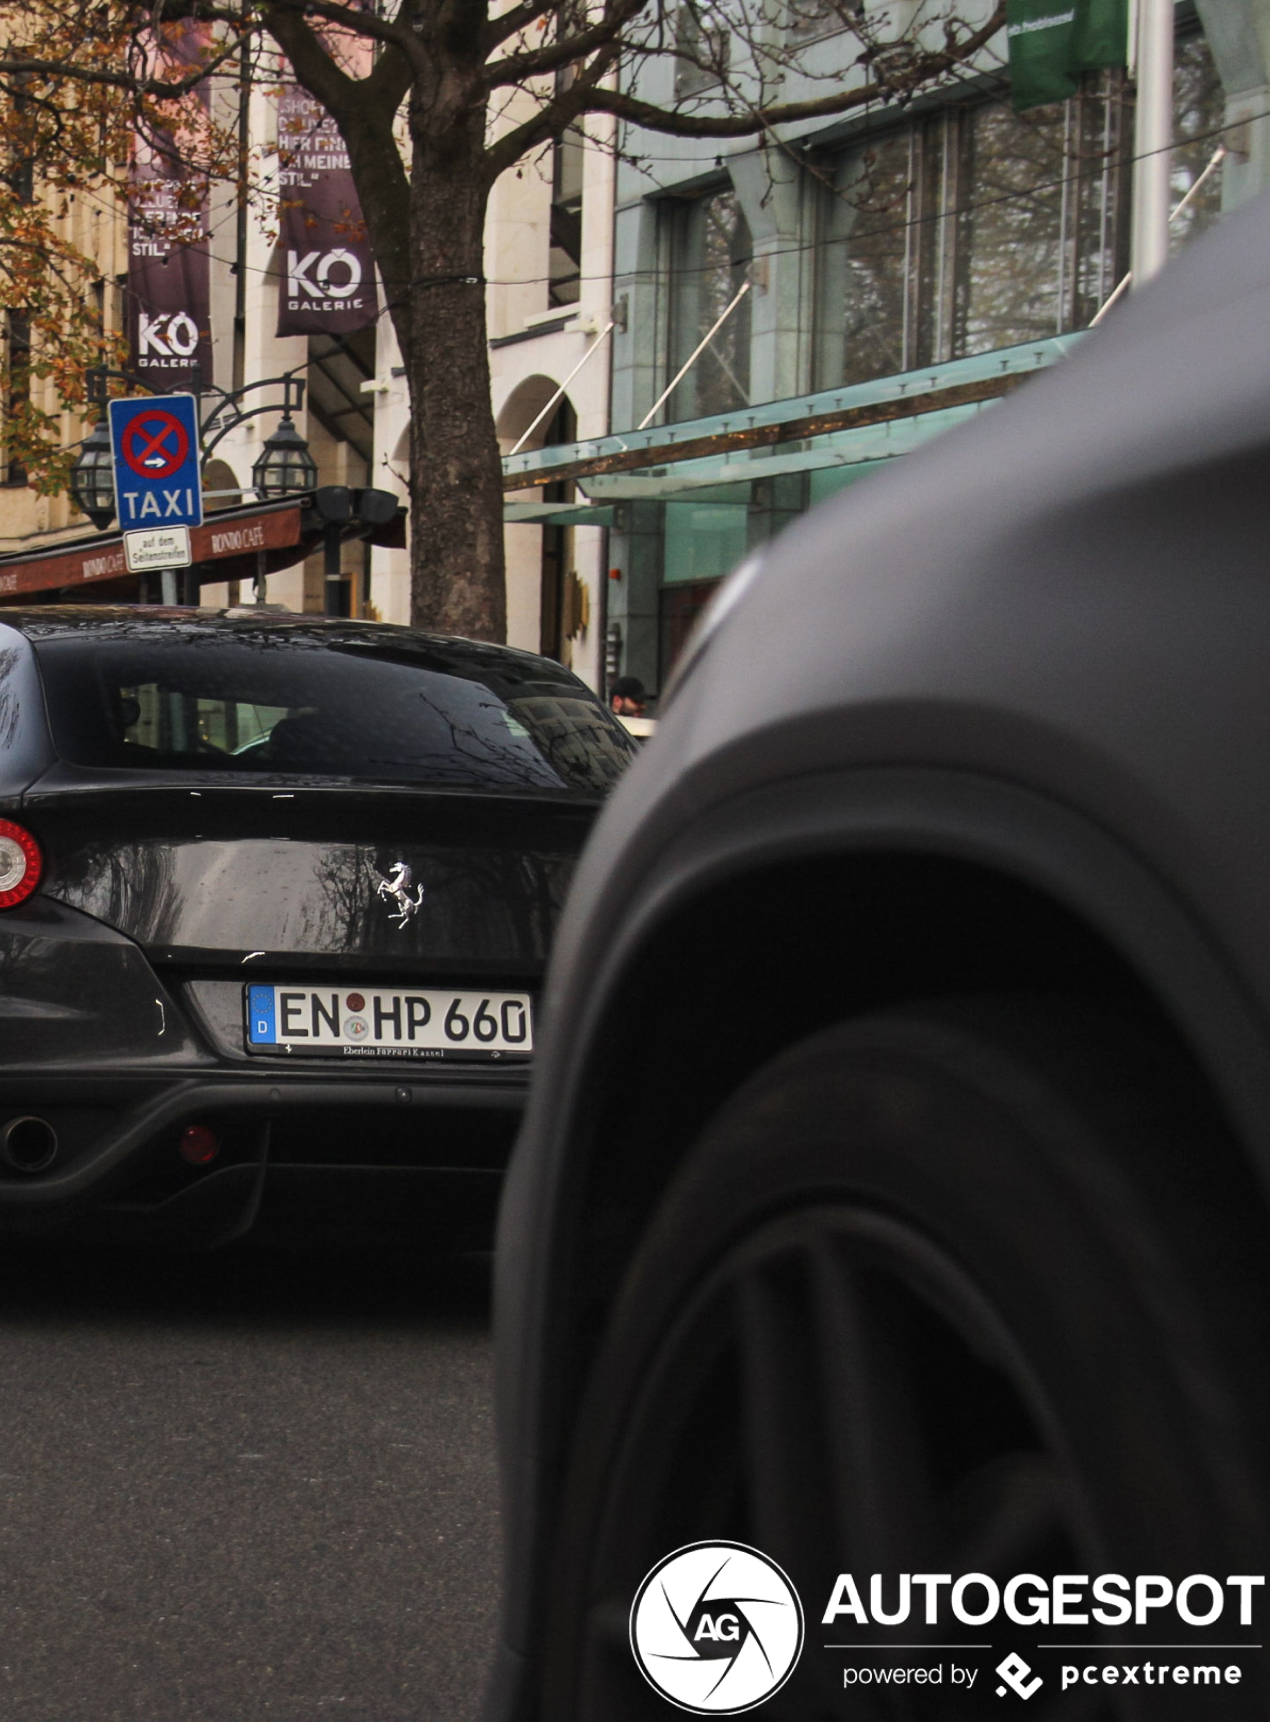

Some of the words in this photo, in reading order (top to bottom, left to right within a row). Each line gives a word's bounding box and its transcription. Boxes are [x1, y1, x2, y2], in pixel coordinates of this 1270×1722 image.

[288, 299, 363, 311] GALERIE
[123, 488, 193, 520] TAXI
[142, 536, 156, 549] auf
[158, 536, 175, 547] dem
[132, 545, 186, 564] Seitenstreifen
[280, 992, 341, 1038] EN
[373, 995, 432, 1041] HP
[444, 998, 527, 1044] 660
[257, 1020, 268, 1034] D
[343, 1046, 376, 1056] Eberlein
